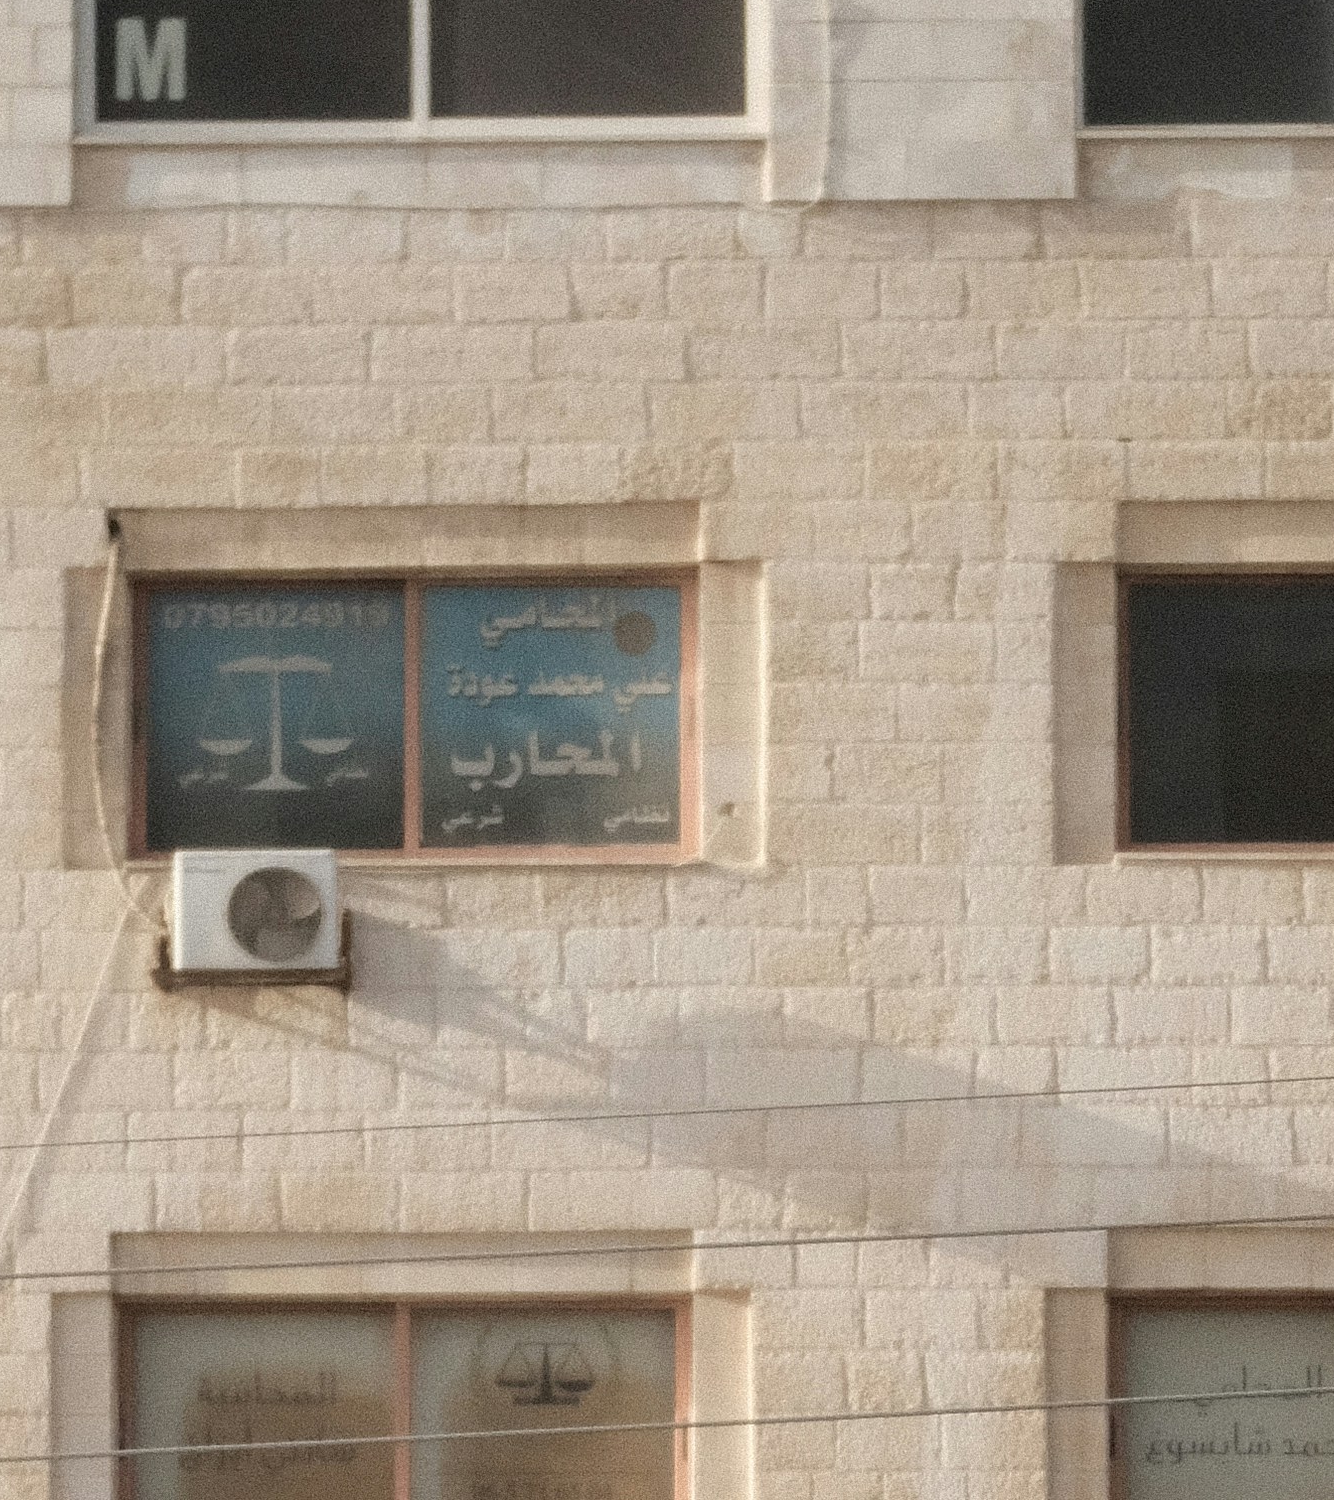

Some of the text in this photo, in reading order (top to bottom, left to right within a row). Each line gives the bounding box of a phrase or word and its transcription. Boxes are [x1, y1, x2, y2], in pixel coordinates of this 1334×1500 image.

[480, 594, 617, 649] المحامي
[527, 668, 606, 697] محمد
[613, 670, 673, 713] علي
[450, 729, 643, 792] المحارب
